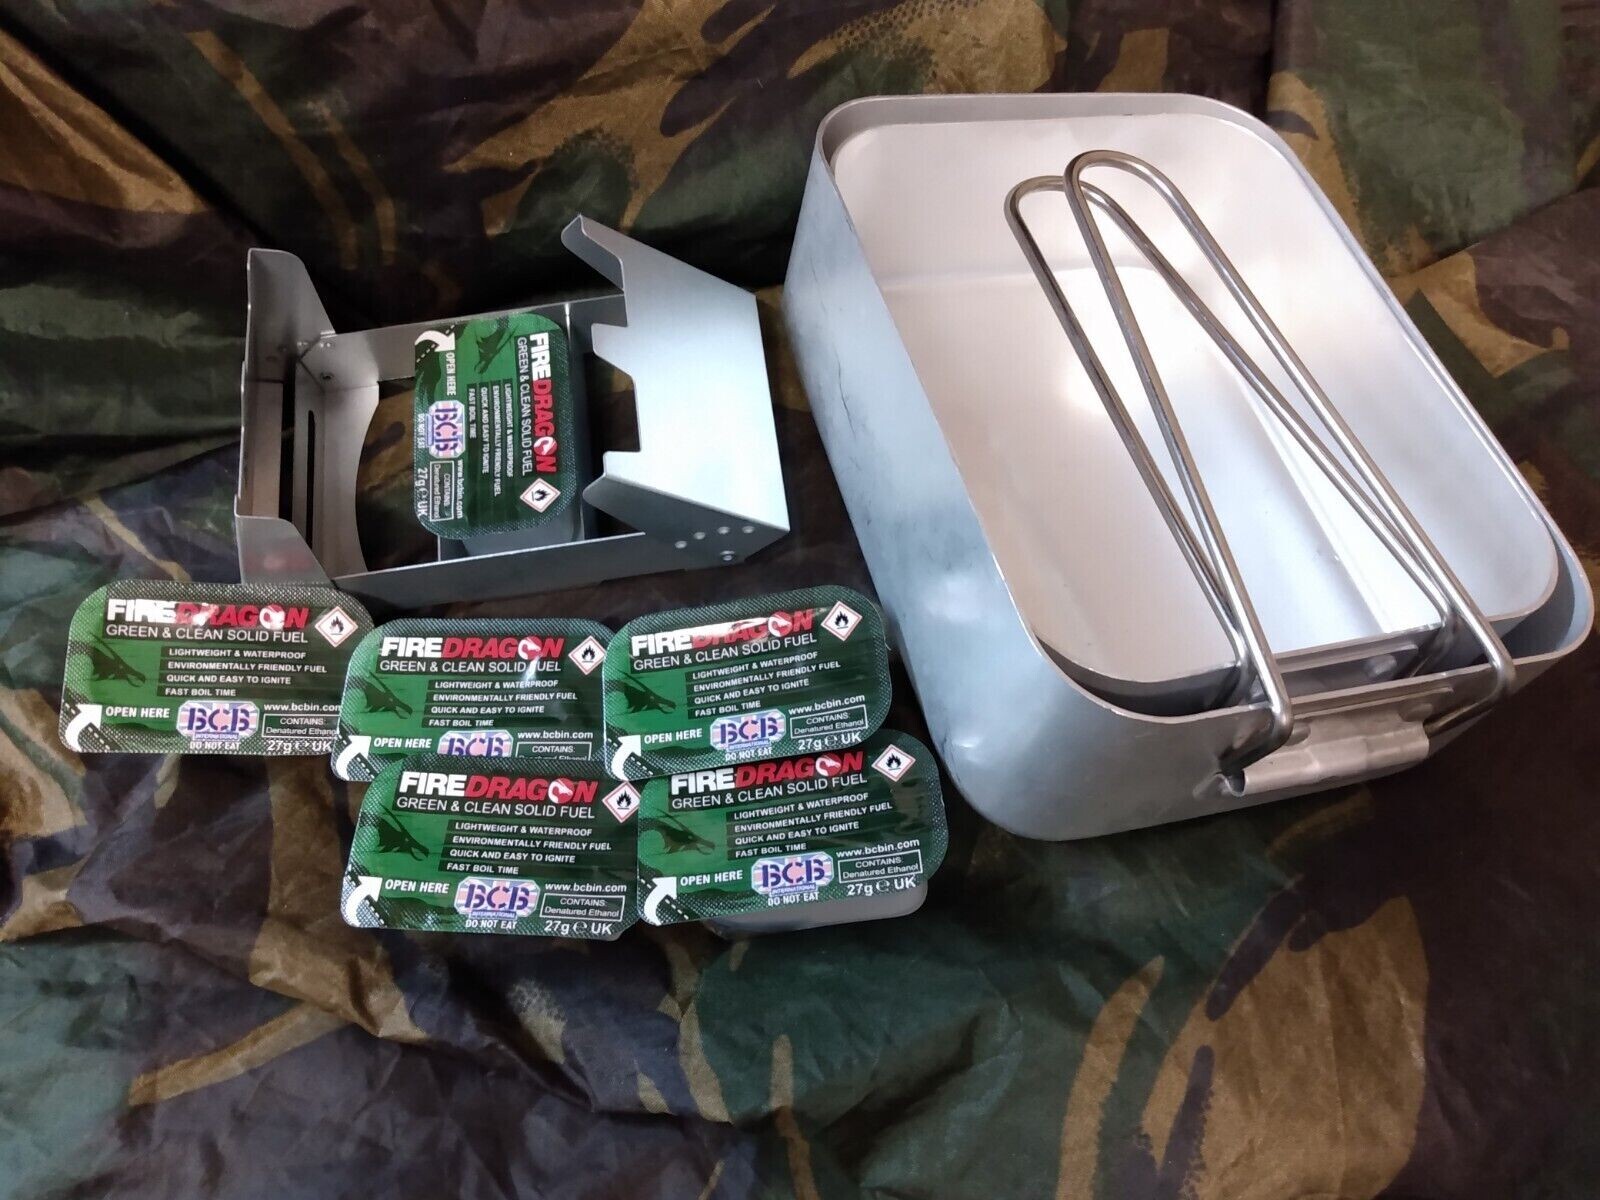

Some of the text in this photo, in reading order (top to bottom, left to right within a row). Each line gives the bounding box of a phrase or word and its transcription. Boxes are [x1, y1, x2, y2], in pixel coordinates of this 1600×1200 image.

[435, 408, 458, 451] BCB
[106, 625, 308, 643] GREEN & CLEAN SOLID FUEL
[169, 649, 306, 659] LIGHTWEIGHT WATERPROOF
[634, 633, 817, 671] GREEN & CLEAN SOLID FUEL
[168, 662, 327, 673] ENVIRONMENTALLY FRIENDLY FUEL
[380, 661, 426, 671] GREEN
[430, 661, 438, 672] &
[442, 661, 484, 672] CLEAN
[488, 661, 525, 672] SOLID
[692, 652, 818, 679] LIGHTWEIGHT WATERPROOF
[167, 674, 291, 684] QUICK AND EASY IGNITE
[694, 661, 841, 692] ENVIRONMENTALLY FRIENDLY FUEL
[165, 688, 236, 696] FAST BOIL TIME
[435, 680, 559, 689] LIGHTWEIGHT WATERPROOF
[694, 679, 809, 704] QUICK AND EASY IGNITE
[556, 692, 577, 700] FUEL
[106, 707, 170, 718] OPEN HERE
[431, 706, 457, 714] QUICK
[480, 706, 502, 714] EASY
[695, 701, 761, 717] FAST BOIL TIME
[788, 695, 865, 715] www.bcbin.com
[187, 707, 250, 732] BCB
[429, 719, 450, 727] FAST
[452, 719, 473, 727] BOIL
[518, 730, 593, 739] www.bcbin.com
[644, 729, 702, 744] OPEN HERE
[720, 717, 778, 744] BCB
[268, 740, 331, 754] 27g UK
[374, 738, 432, 748] OPEN HERE
[799, 732, 861, 751] 27g UK
[672, 773, 867, 809] GREEN & CLEAN SOLID FUEL
[397, 797, 595, 818] GREEN & CLEAN SOLID FUEL
[734, 793, 869, 820] LIGHTWEIGHT WATERPROOF
[735, 802, 892, 832] ENVIRONMENTALLY FRIENDLY FUEL
[456, 823, 592, 836] LIGHTWEIGHT WATERPROOF
[735, 822, 859, 845] QUICK AND EASY IGNITE
[453, 836, 541, 848] ENVIRONMENTALLY
[543, 841, 587, 850] FRIENDLY
[735, 843, 806, 857] FAST BOIL TIME
[836, 839, 919, 857] www.bcbin.com
[450, 850, 575, 863] QUICK AND EASY IGNITE
[447, 863, 518, 874] FAST BOIL TIME
[763, 859, 824, 887] BCB
[681, 870, 743, 886] OPEN HERE
[385, 879, 449, 893] OPEN HERE
[545, 883, 626, 892] www.bcbin.com
[848, 877, 916, 896] 27g UK
[465, 884, 529, 910] BCB
[544, 921, 612, 934] 27g UK
